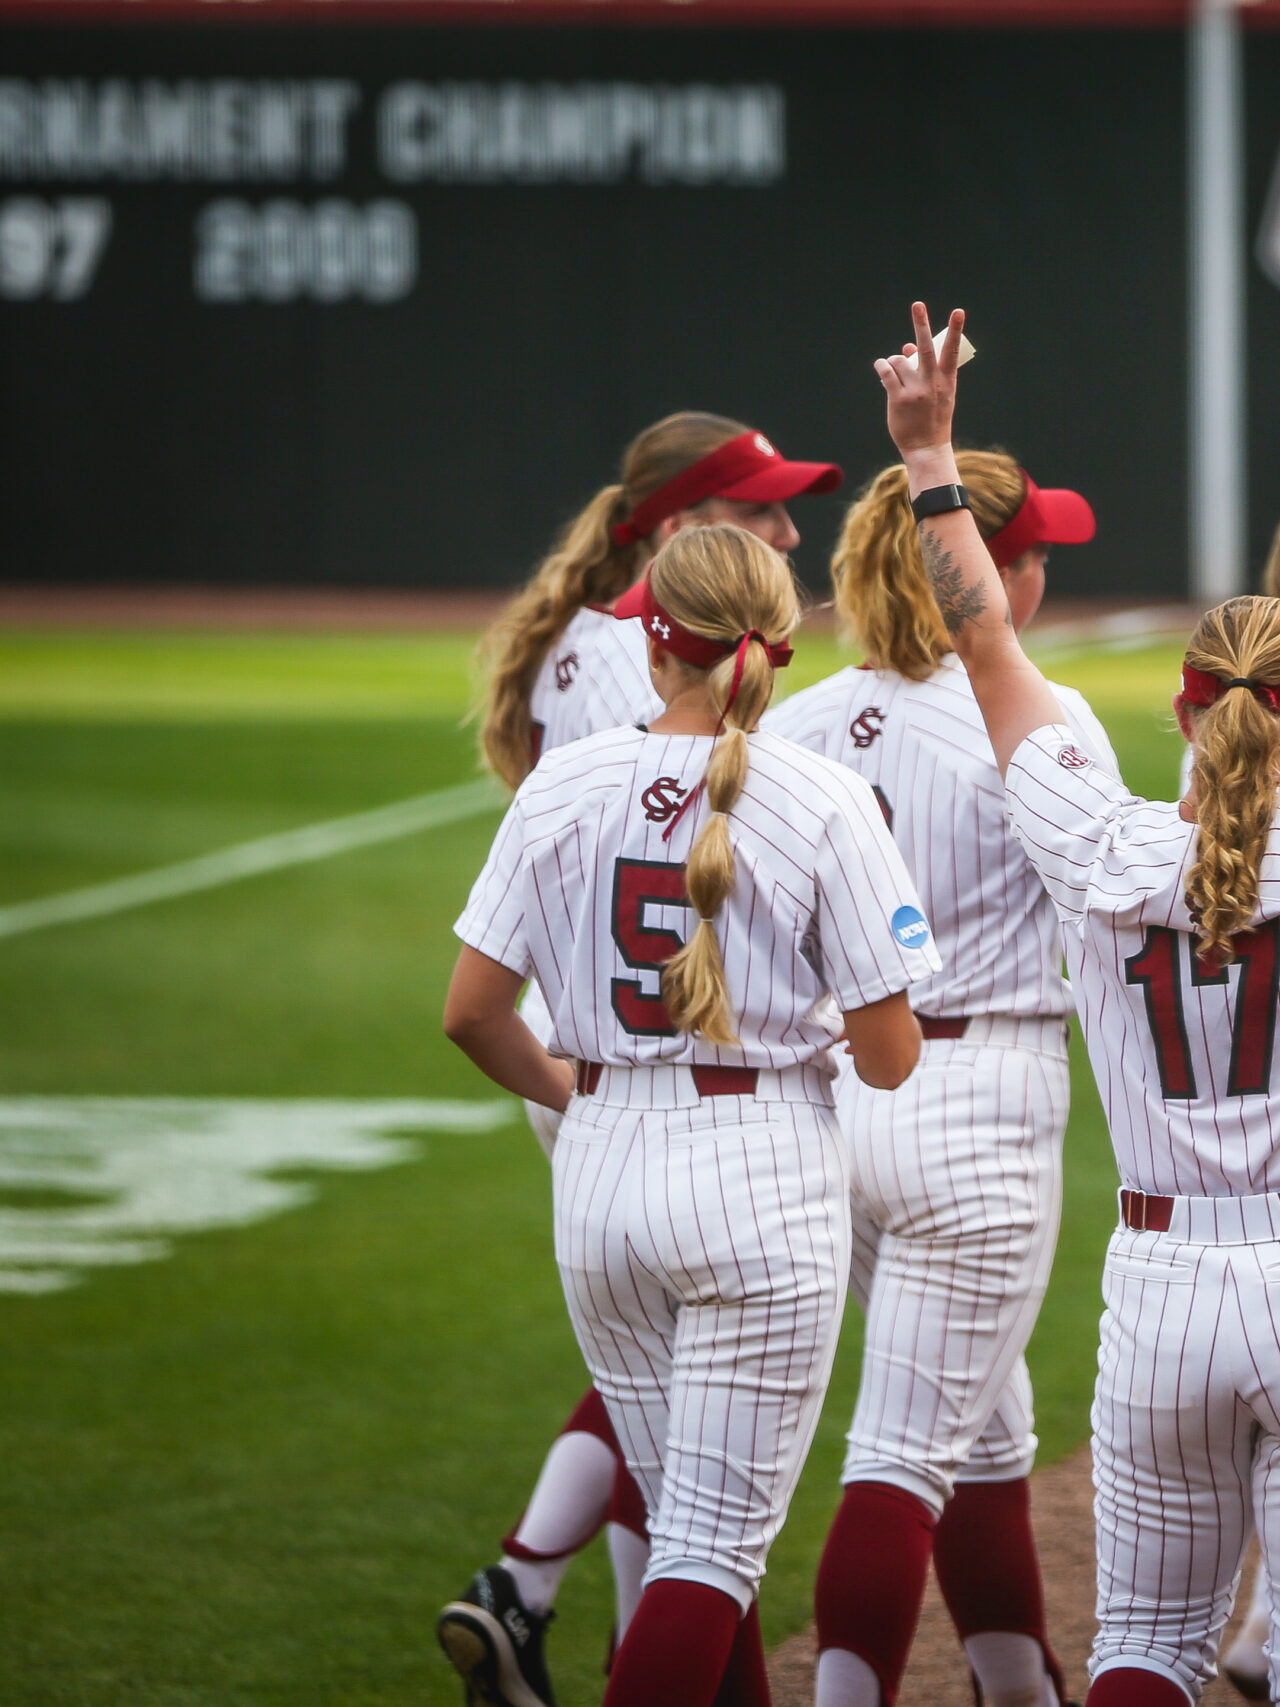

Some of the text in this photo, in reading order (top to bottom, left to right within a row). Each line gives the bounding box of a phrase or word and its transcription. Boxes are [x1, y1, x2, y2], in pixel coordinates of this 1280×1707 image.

[379, 81, 786, 183] CHAMPION
[0, 199, 417, 302] 97 2000
[611, 857, 697, 1038] 5
